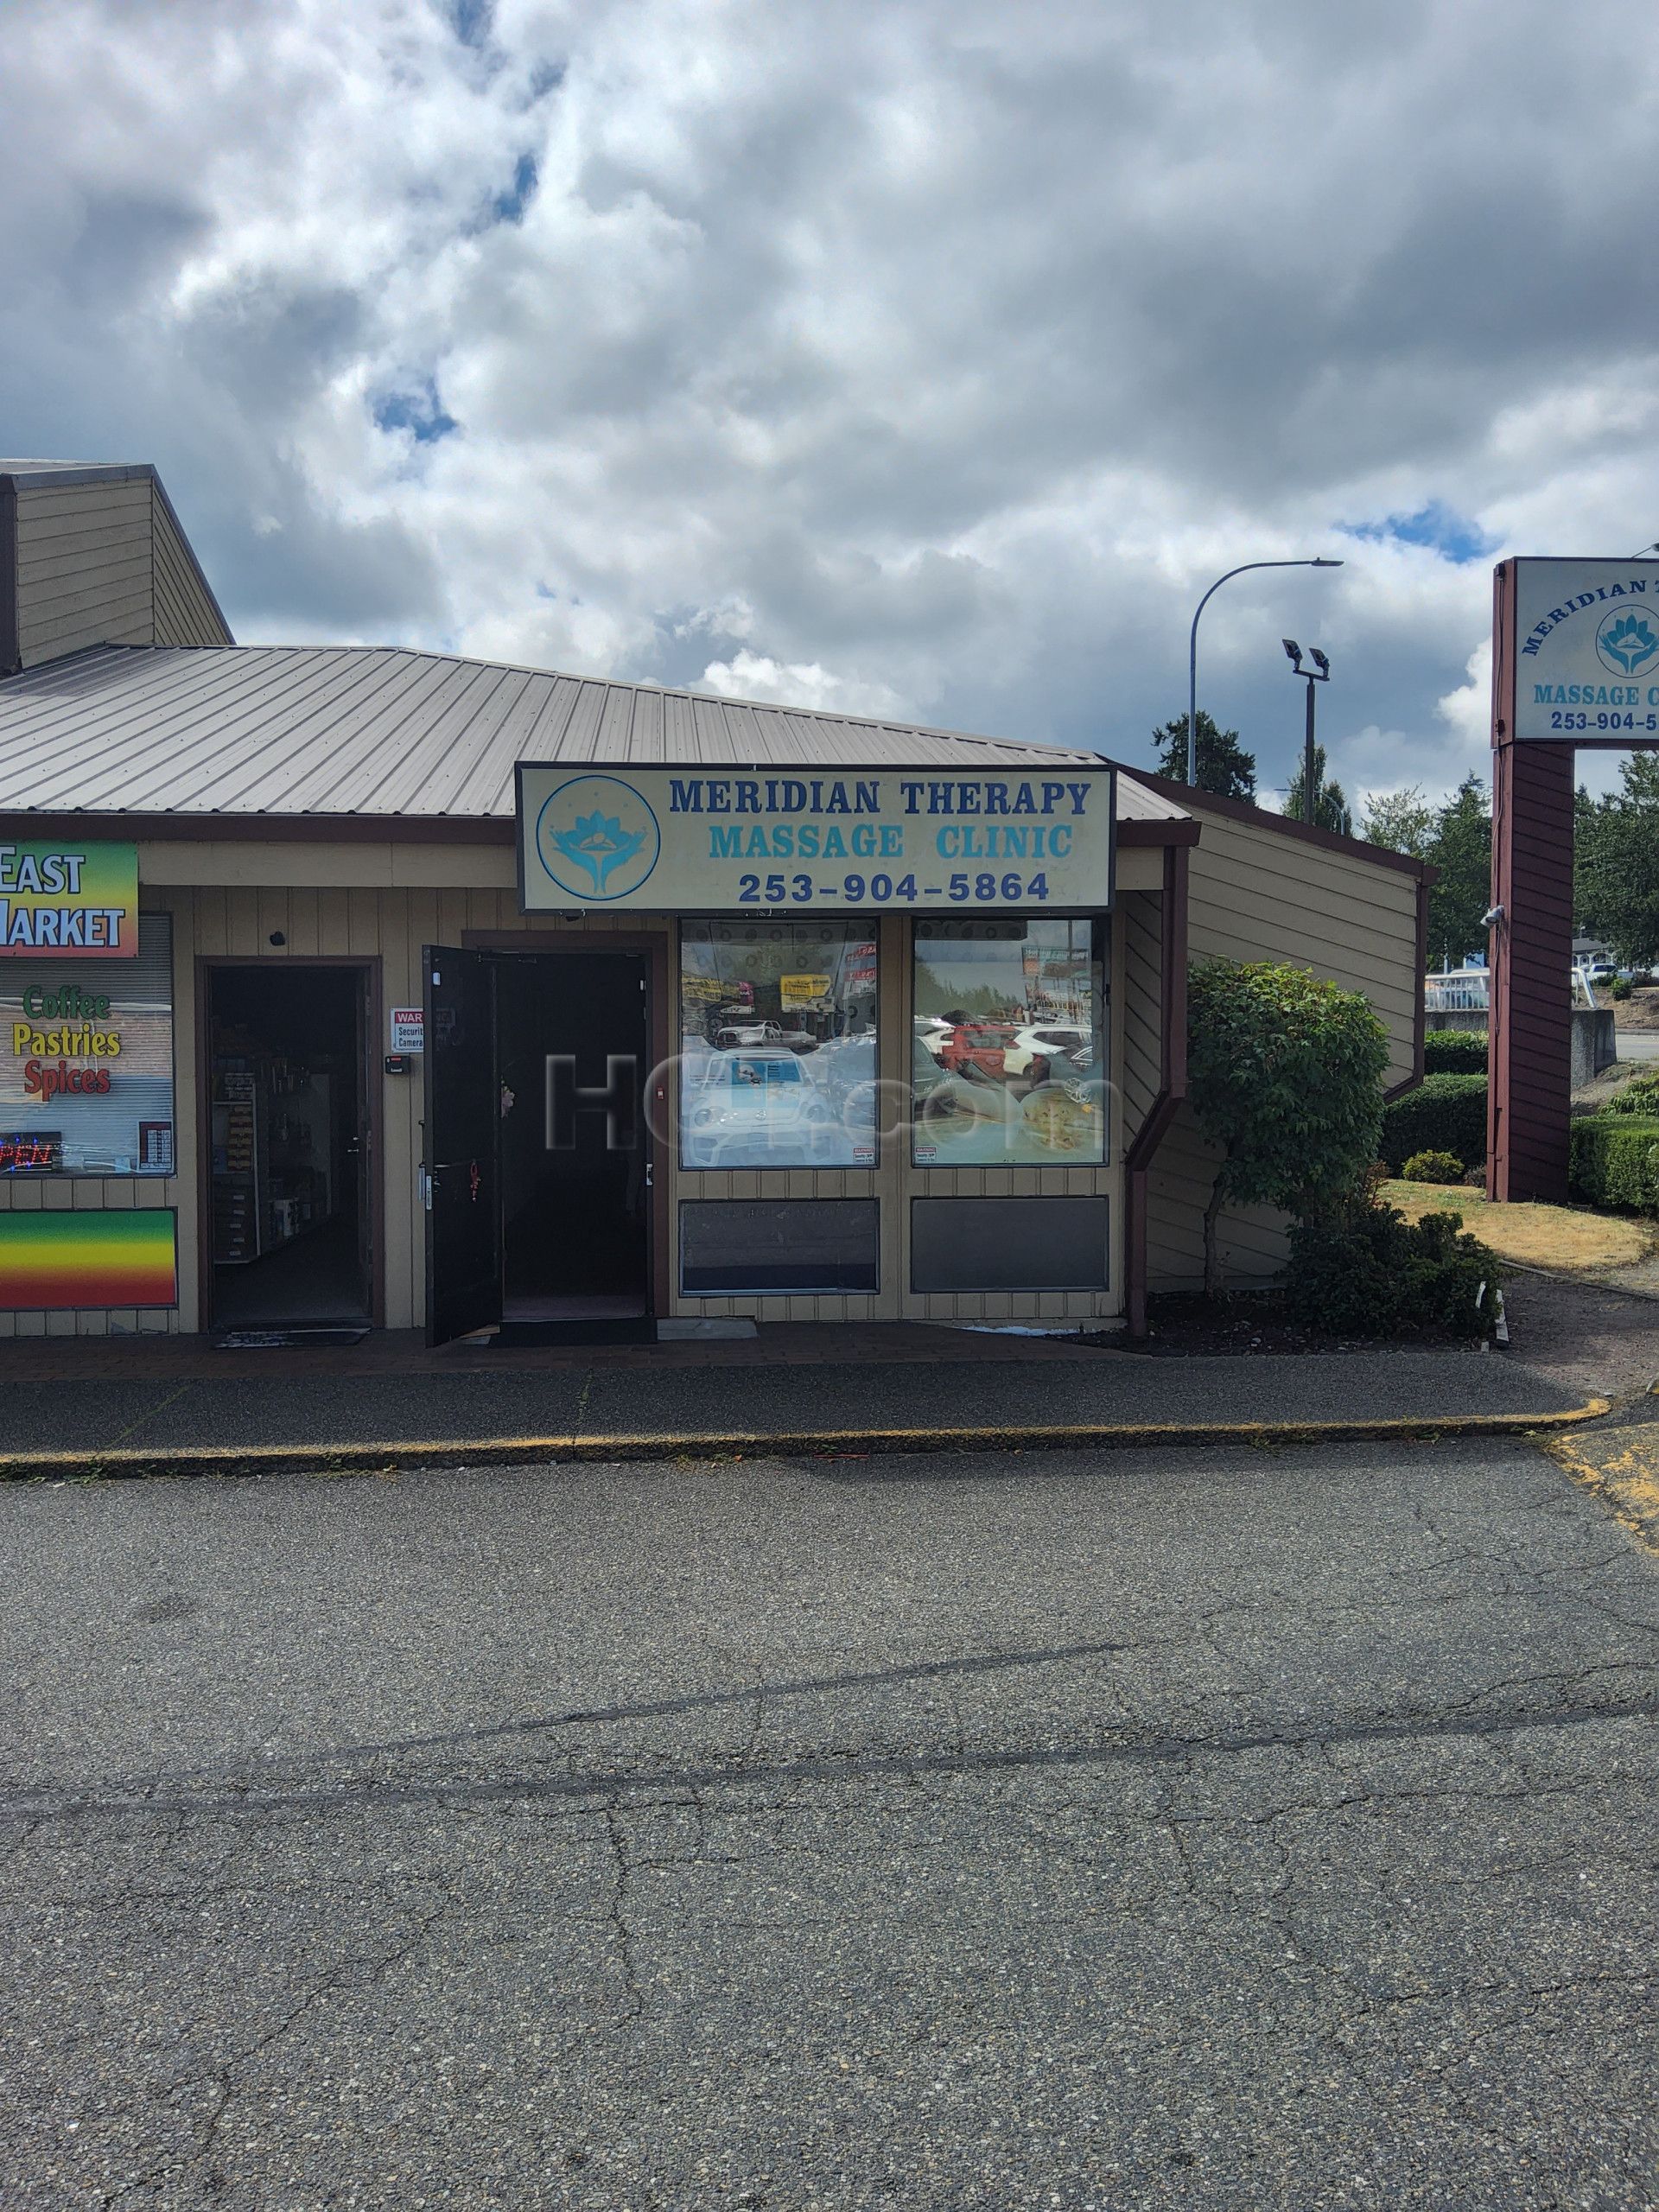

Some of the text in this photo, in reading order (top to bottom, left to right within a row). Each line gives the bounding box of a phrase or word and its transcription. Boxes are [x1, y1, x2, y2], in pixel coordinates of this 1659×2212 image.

[1522, 580, 1647, 657] MERIDIAN
[1534, 684, 1659, 707] MASSAGE C
[1551, 711, 1658, 731] 253-904-5
[669, 779, 1093, 816] MERIDIAN THERAPY
[709, 823, 1072, 859] MASSAGE CLINIC
[0, 846, 85, 894] EAST
[739, 873, 1049, 903] 253-904-5864
[22, 985, 111, 1020] Coffee
[13, 1022, 121, 1057] Pastries
[398, 1027, 423, 1036] Securit
[398, 1038, 423, 1047] Camera
[24, 1059, 111, 1102] Spices
[0, 1145, 50, 1164] PEN
